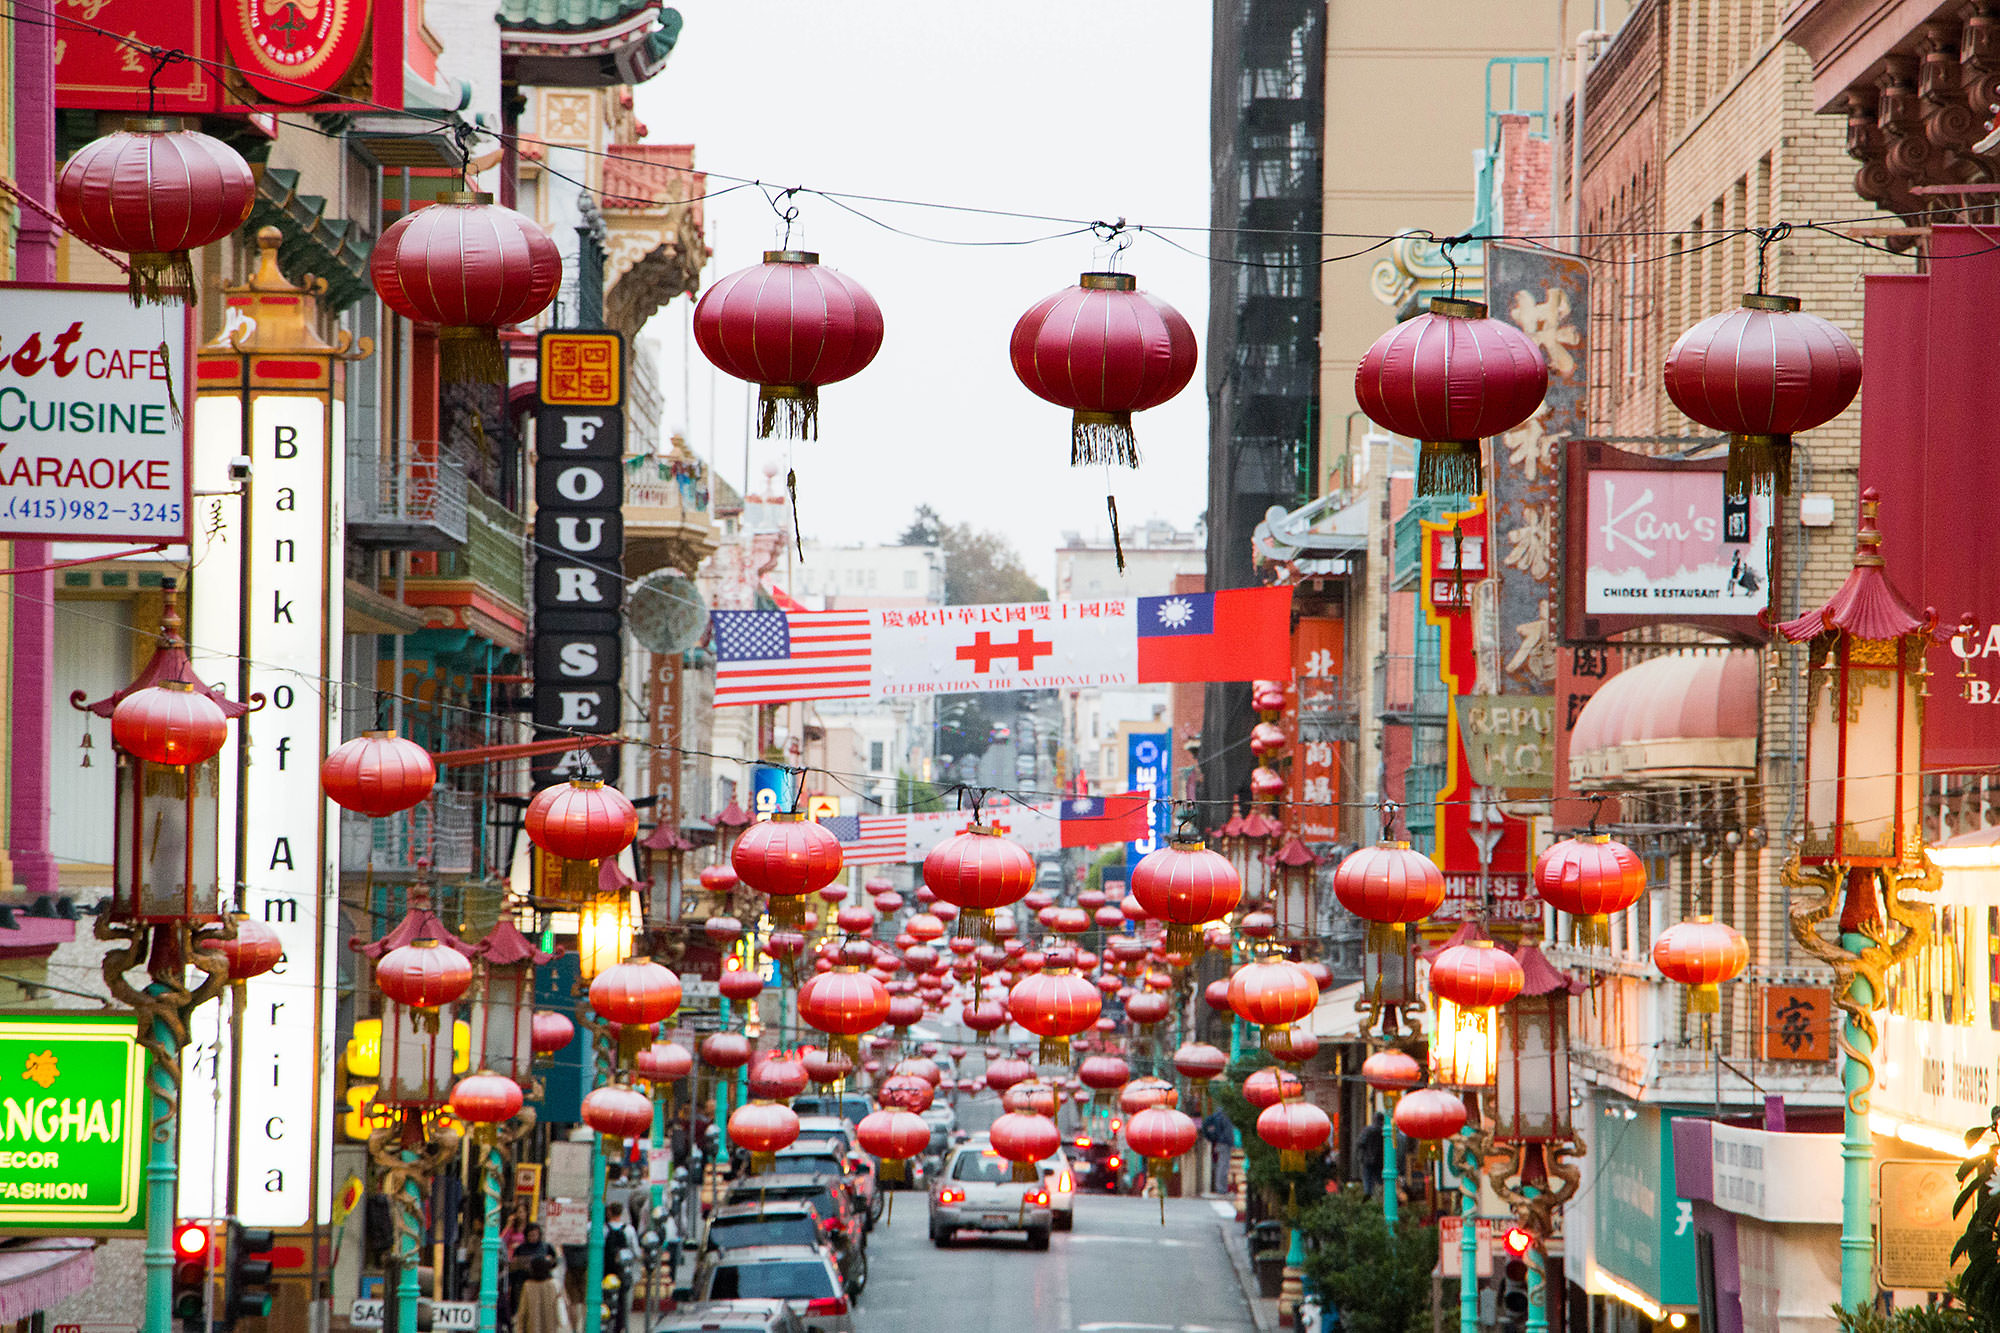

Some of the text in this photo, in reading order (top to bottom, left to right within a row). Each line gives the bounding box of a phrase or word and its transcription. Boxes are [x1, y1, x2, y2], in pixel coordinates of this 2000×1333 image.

[86, 348, 168, 380] CAFE
[555, 415, 604, 602] FOUR
[1600, 480, 1716, 559] Kan's
[1603, 588, 1720, 599] CHINESE RESTAURANT
[658, 666, 675, 759] GIFTS
[883, 672, 1127, 695] CELEBRATION THE NATIONAL DAY
[264, 425, 298, 1193] Bank of America
[0, 1097, 122, 1143] NGHAI
